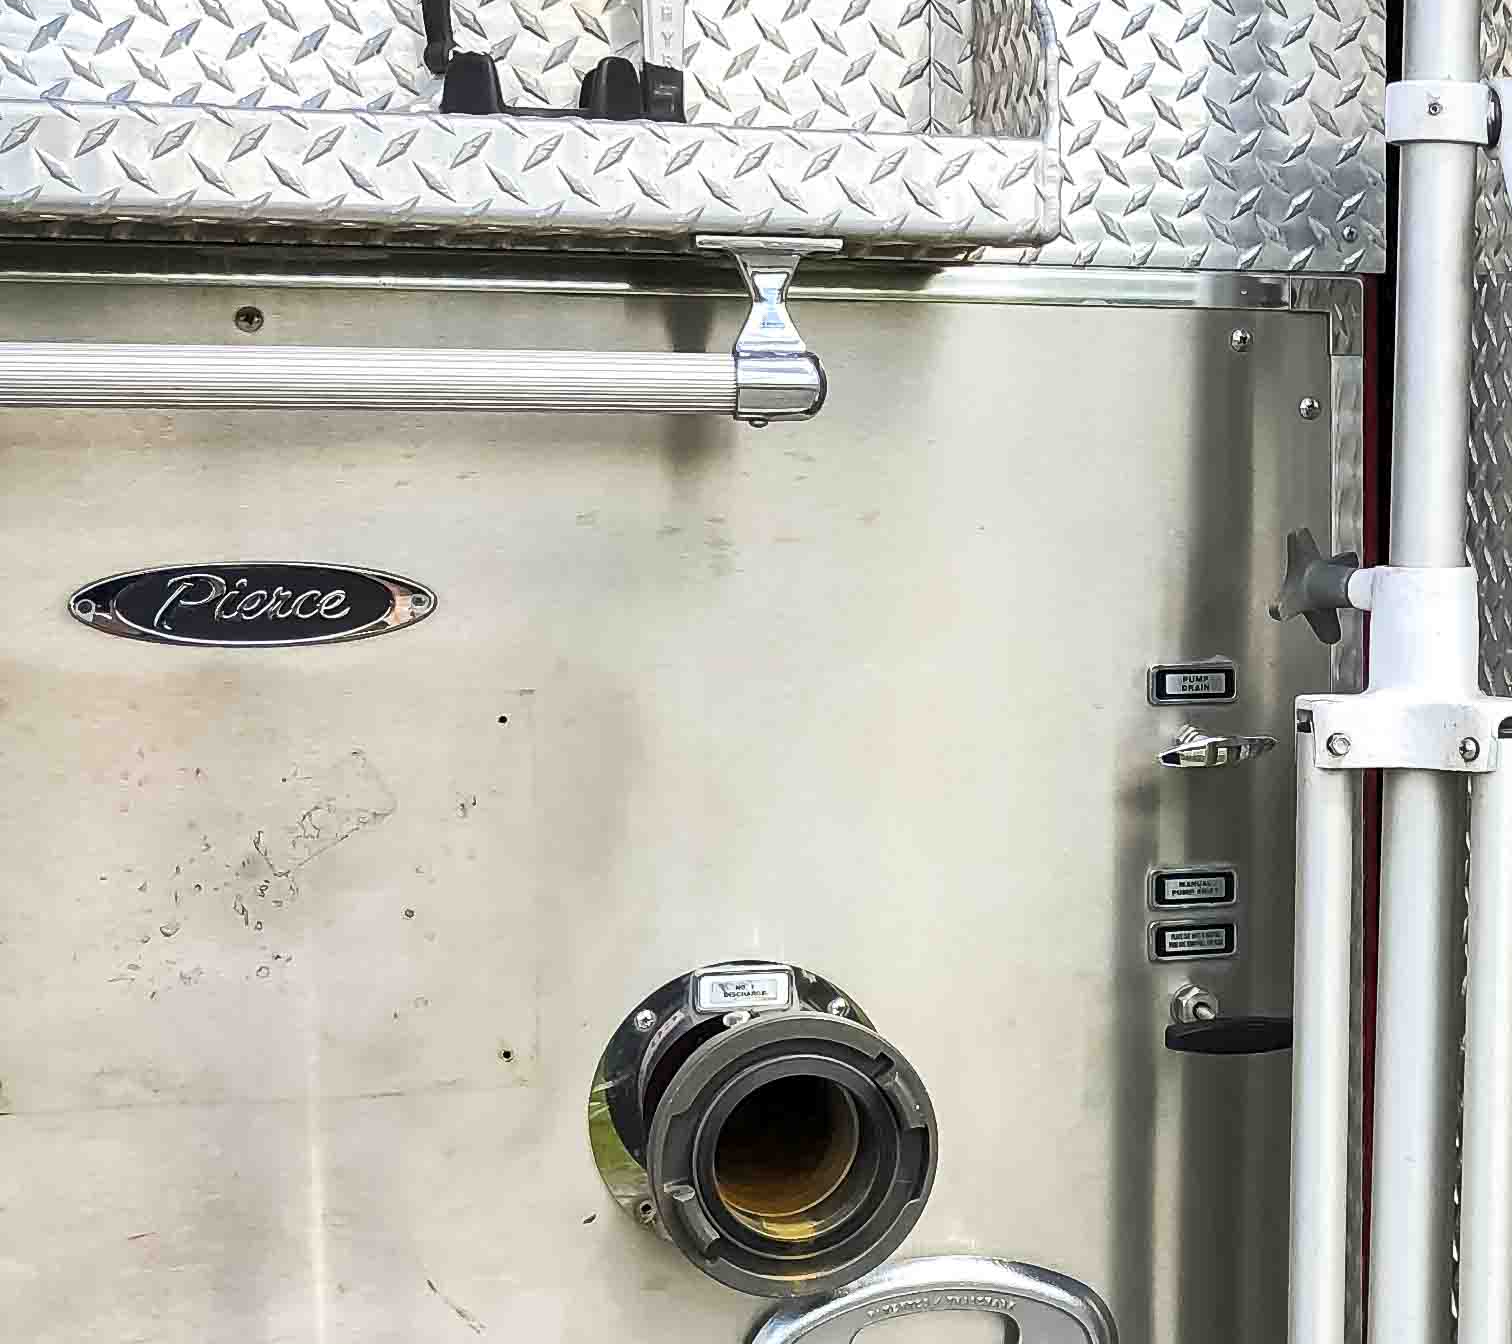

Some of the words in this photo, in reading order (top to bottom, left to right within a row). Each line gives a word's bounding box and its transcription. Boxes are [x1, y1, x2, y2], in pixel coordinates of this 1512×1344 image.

[153, 573, 352, 631] Pierce
[1182, 675, 1209, 683] PUMP
[1181, 684, 1210, 692] DRAIN
[723, 990, 768, 998] DISCHARGE
